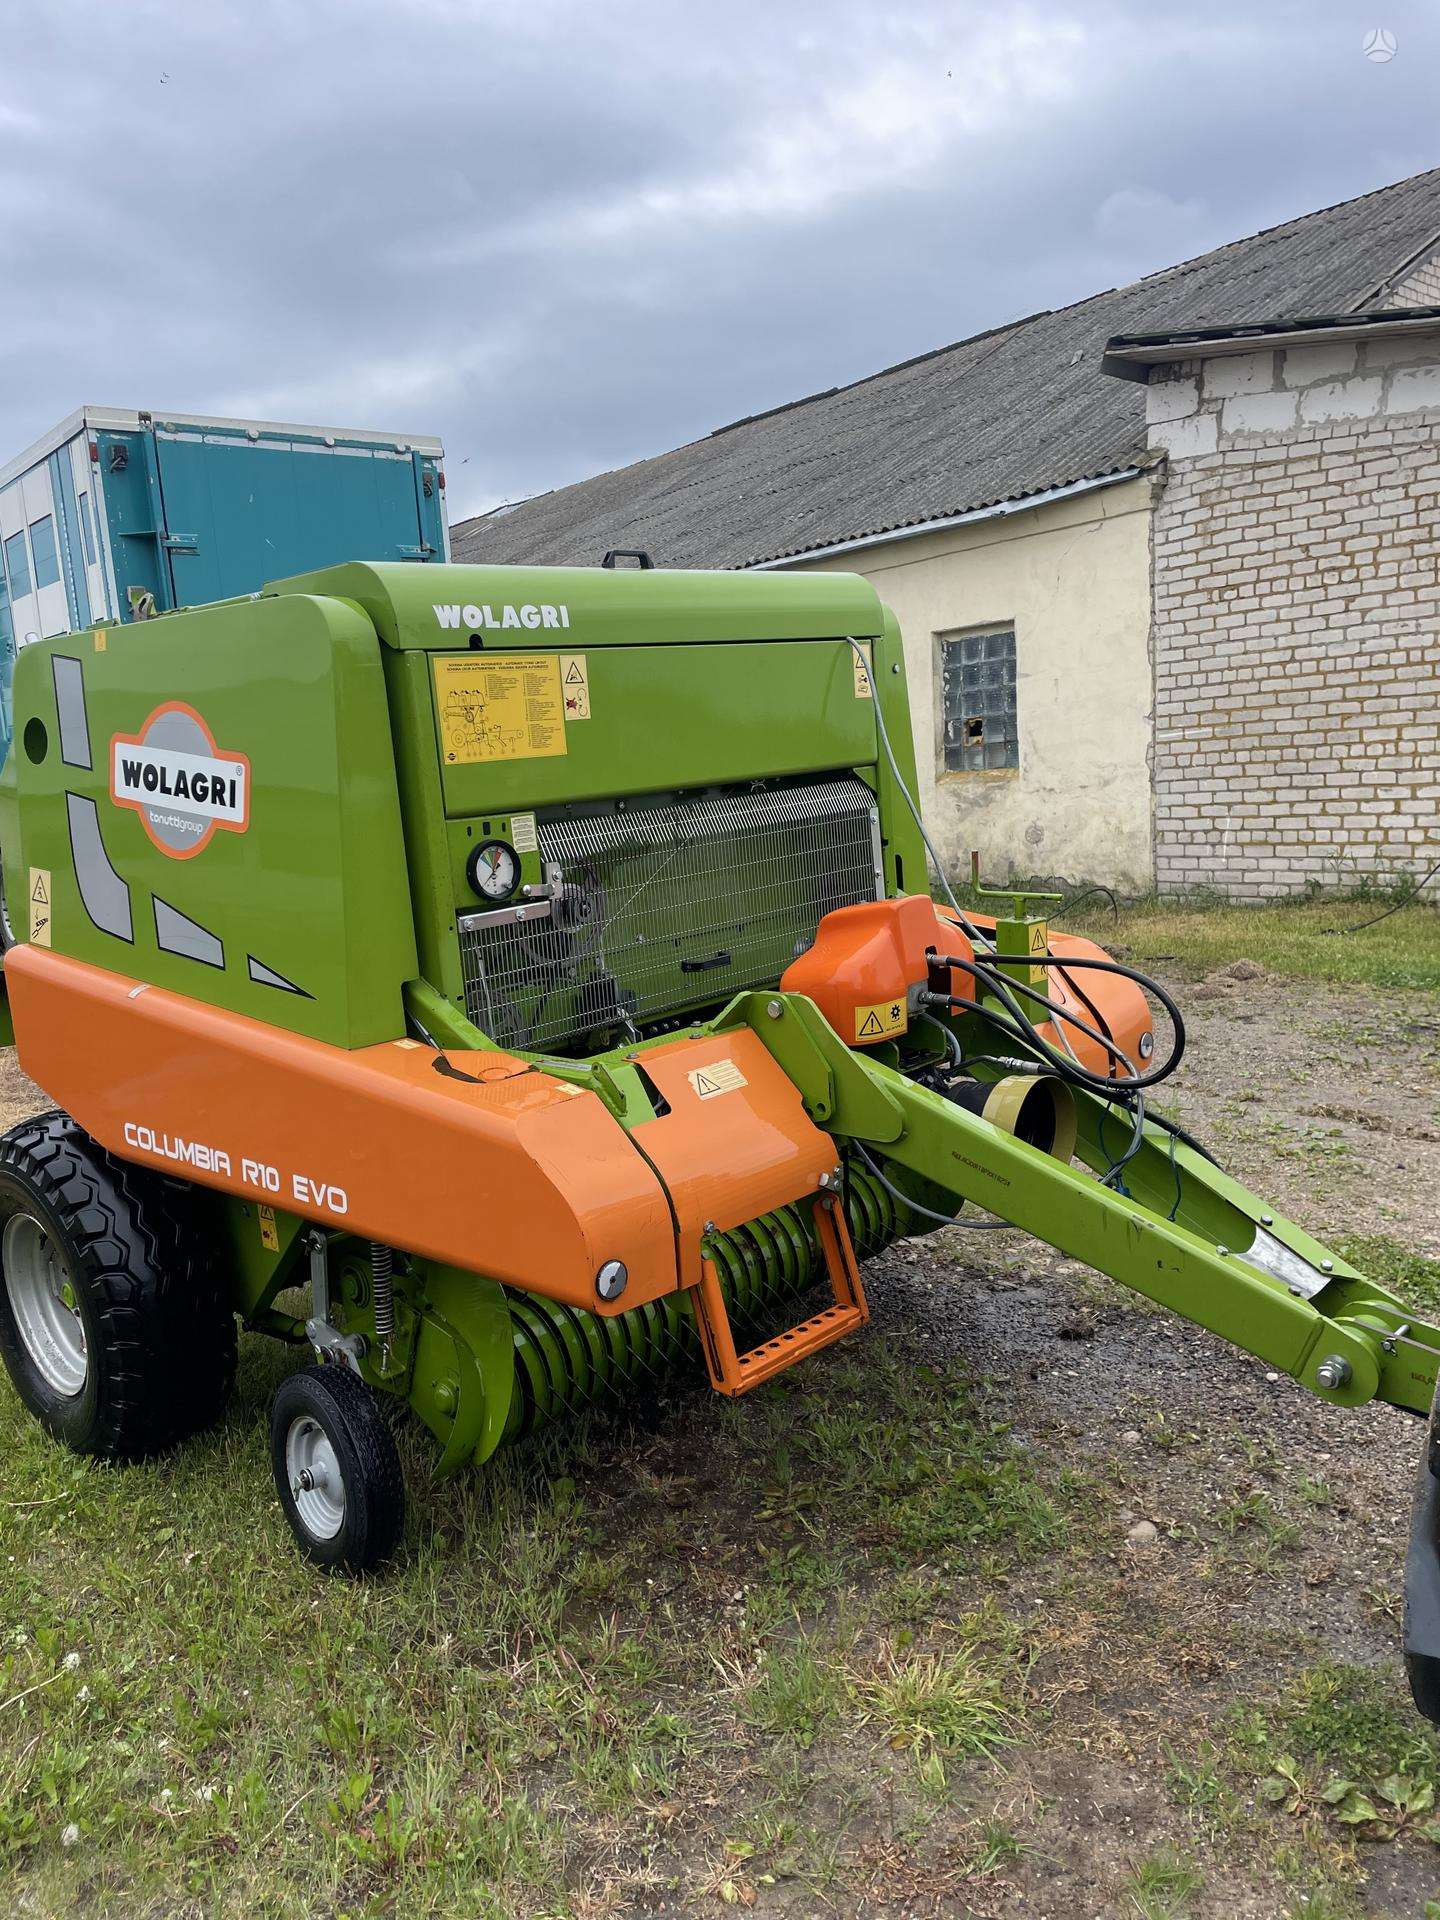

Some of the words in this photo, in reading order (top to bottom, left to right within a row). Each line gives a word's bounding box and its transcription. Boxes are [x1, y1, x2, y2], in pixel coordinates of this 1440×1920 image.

[432, 604, 570, 629] WOLAGRI
[121, 759, 236, 809] WOLAGRI
[124, 1122, 231, 1177] COLUMBIA
[241, 1158, 280, 1192] R10
[292, 1174, 349, 1215] EVO
